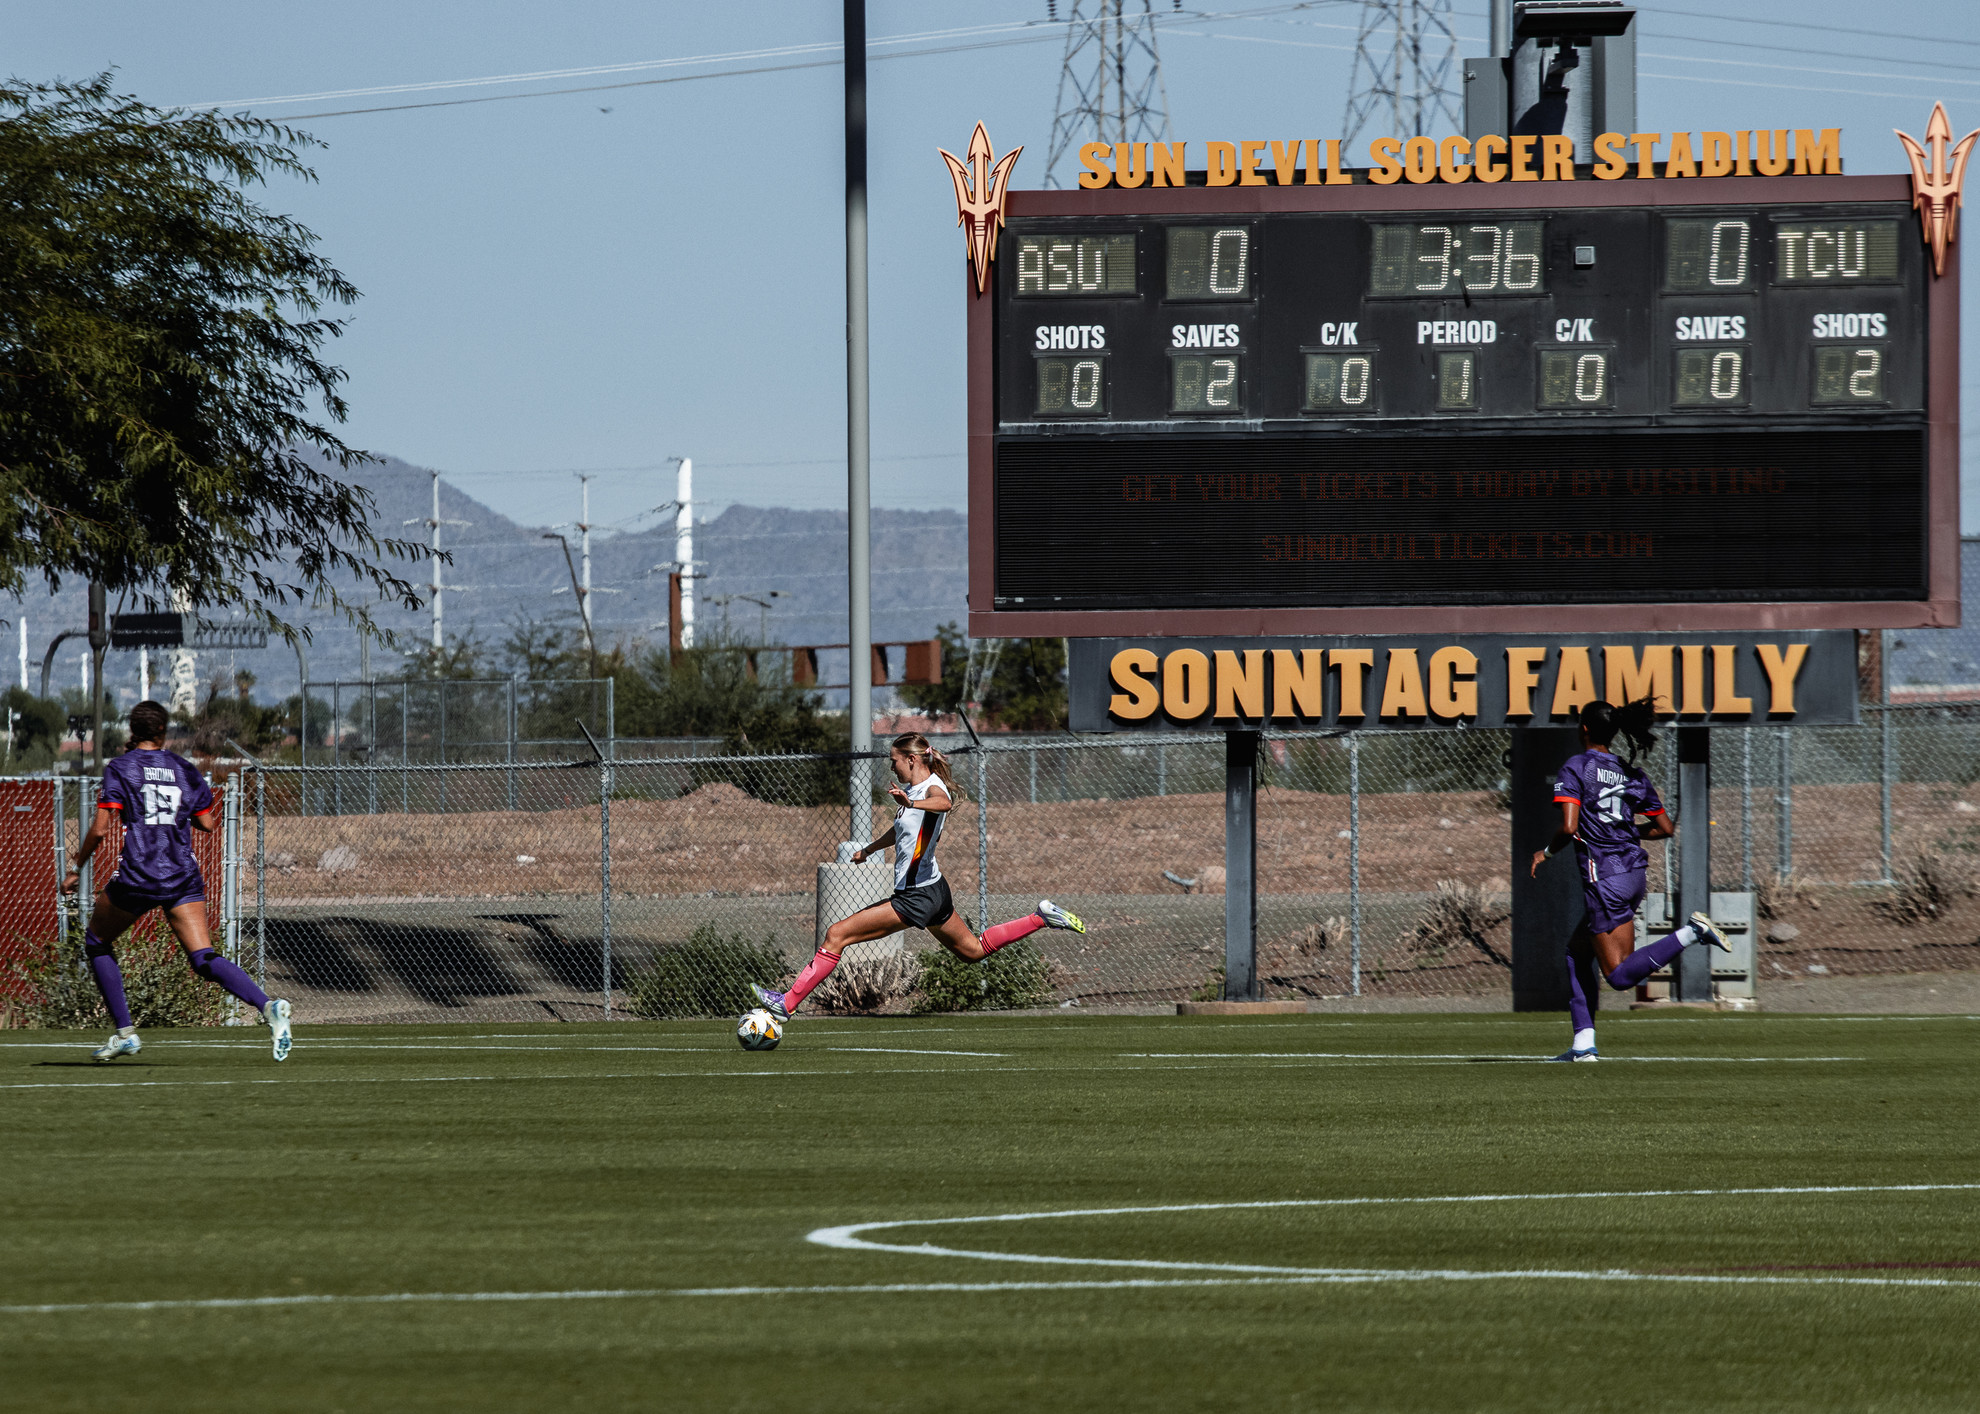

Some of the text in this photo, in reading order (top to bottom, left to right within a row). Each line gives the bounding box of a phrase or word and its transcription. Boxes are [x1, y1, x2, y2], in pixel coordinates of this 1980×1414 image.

[1078, 128, 1843, 189] SUN DEVIL SOCCER STADIUM
[1018, 245, 1102, 291] ASU
[1209, 229, 1249, 295] 0
[1415, 226, 1540, 291] 3:36
[1708, 221, 1750, 286] 0
[1776, 230, 1867, 279] TCU
[1035, 325, 1106, 350] SHOTS
[1171, 324, 1240, 348] SAVES
[1320, 322, 1358, 346] C/K
[1417, 320, 1497, 344] PERIOD
[1555, 317, 1594, 342] C/K
[1675, 316, 1746, 340] SAVES
[1812, 312, 1887, 338] SHOTS
[1071, 361, 1100, 408] 0
[1206, 359, 1235, 407] 2
[1339, 358, 1370, 404] 0
[1460, 359, 1471, 400] 1
[1574, 354, 1605, 401] 0
[1710, 351, 1742, 399] 0
[1848, 349, 1881, 397] 2
[1122, 467, 1786, 501] GET YOUR TICKETS TODAY BY VISITING
[1262, 530, 1653, 561] SUNDEVILTICKETS.COM
[1108, 643, 1810, 721] SONNTAG FAMILY
